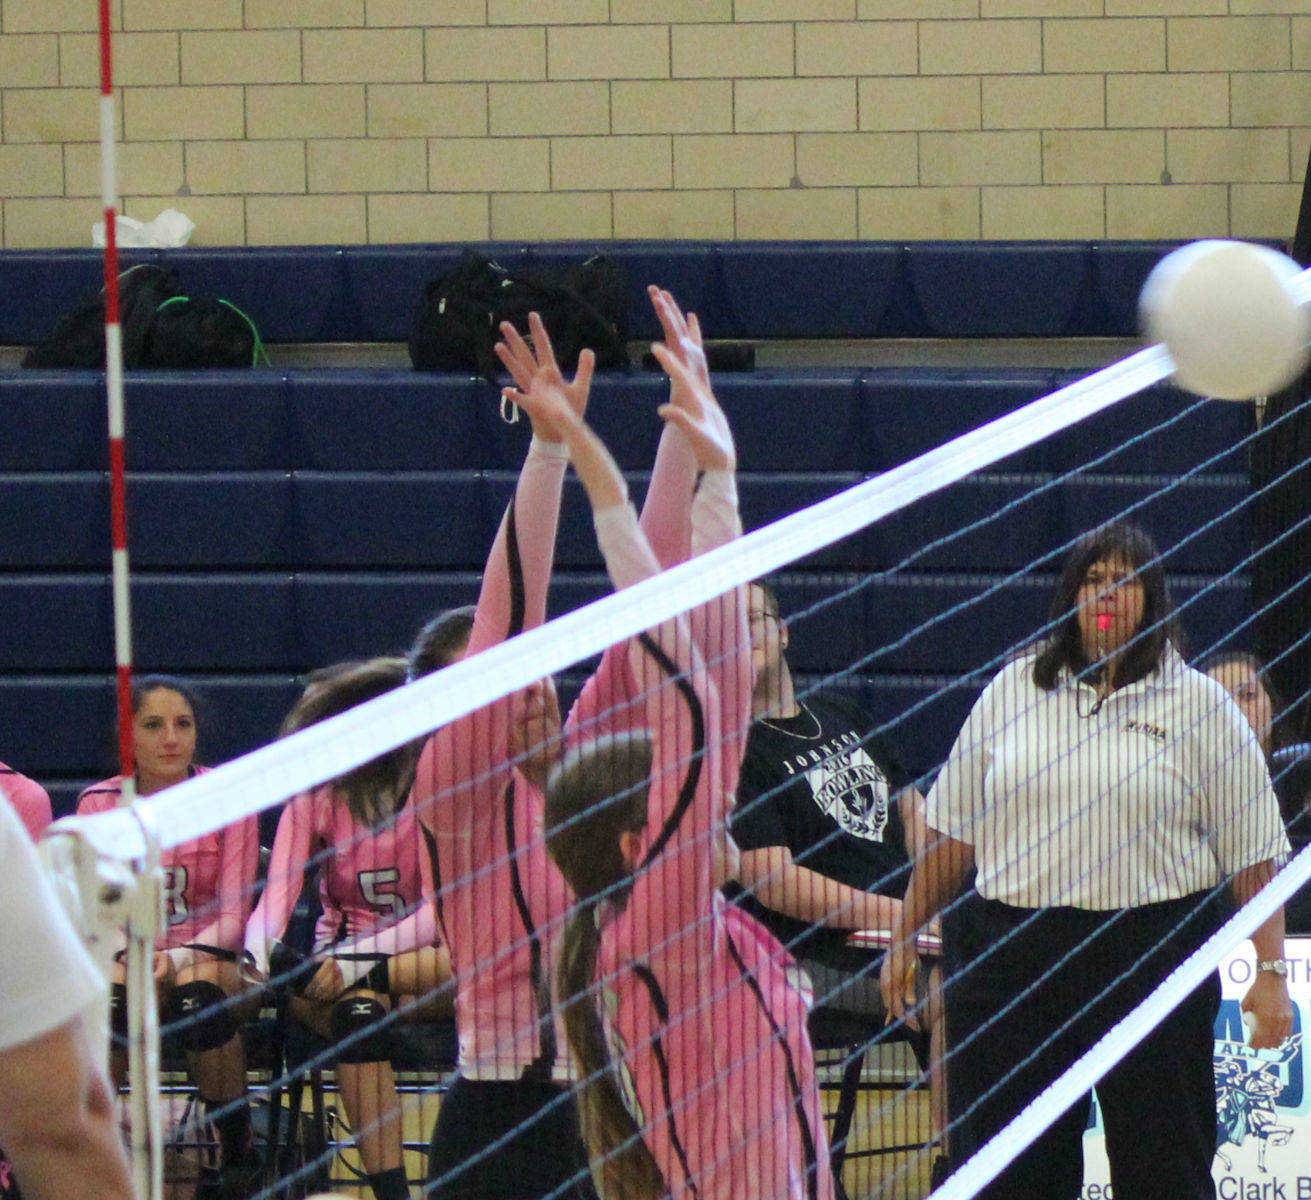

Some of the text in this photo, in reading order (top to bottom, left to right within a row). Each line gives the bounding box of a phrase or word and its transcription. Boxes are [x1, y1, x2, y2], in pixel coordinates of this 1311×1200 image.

[783, 731, 861, 775] JOHNSON
[358, 868, 408, 920] 5
[1228, 958, 1251, 983] O
